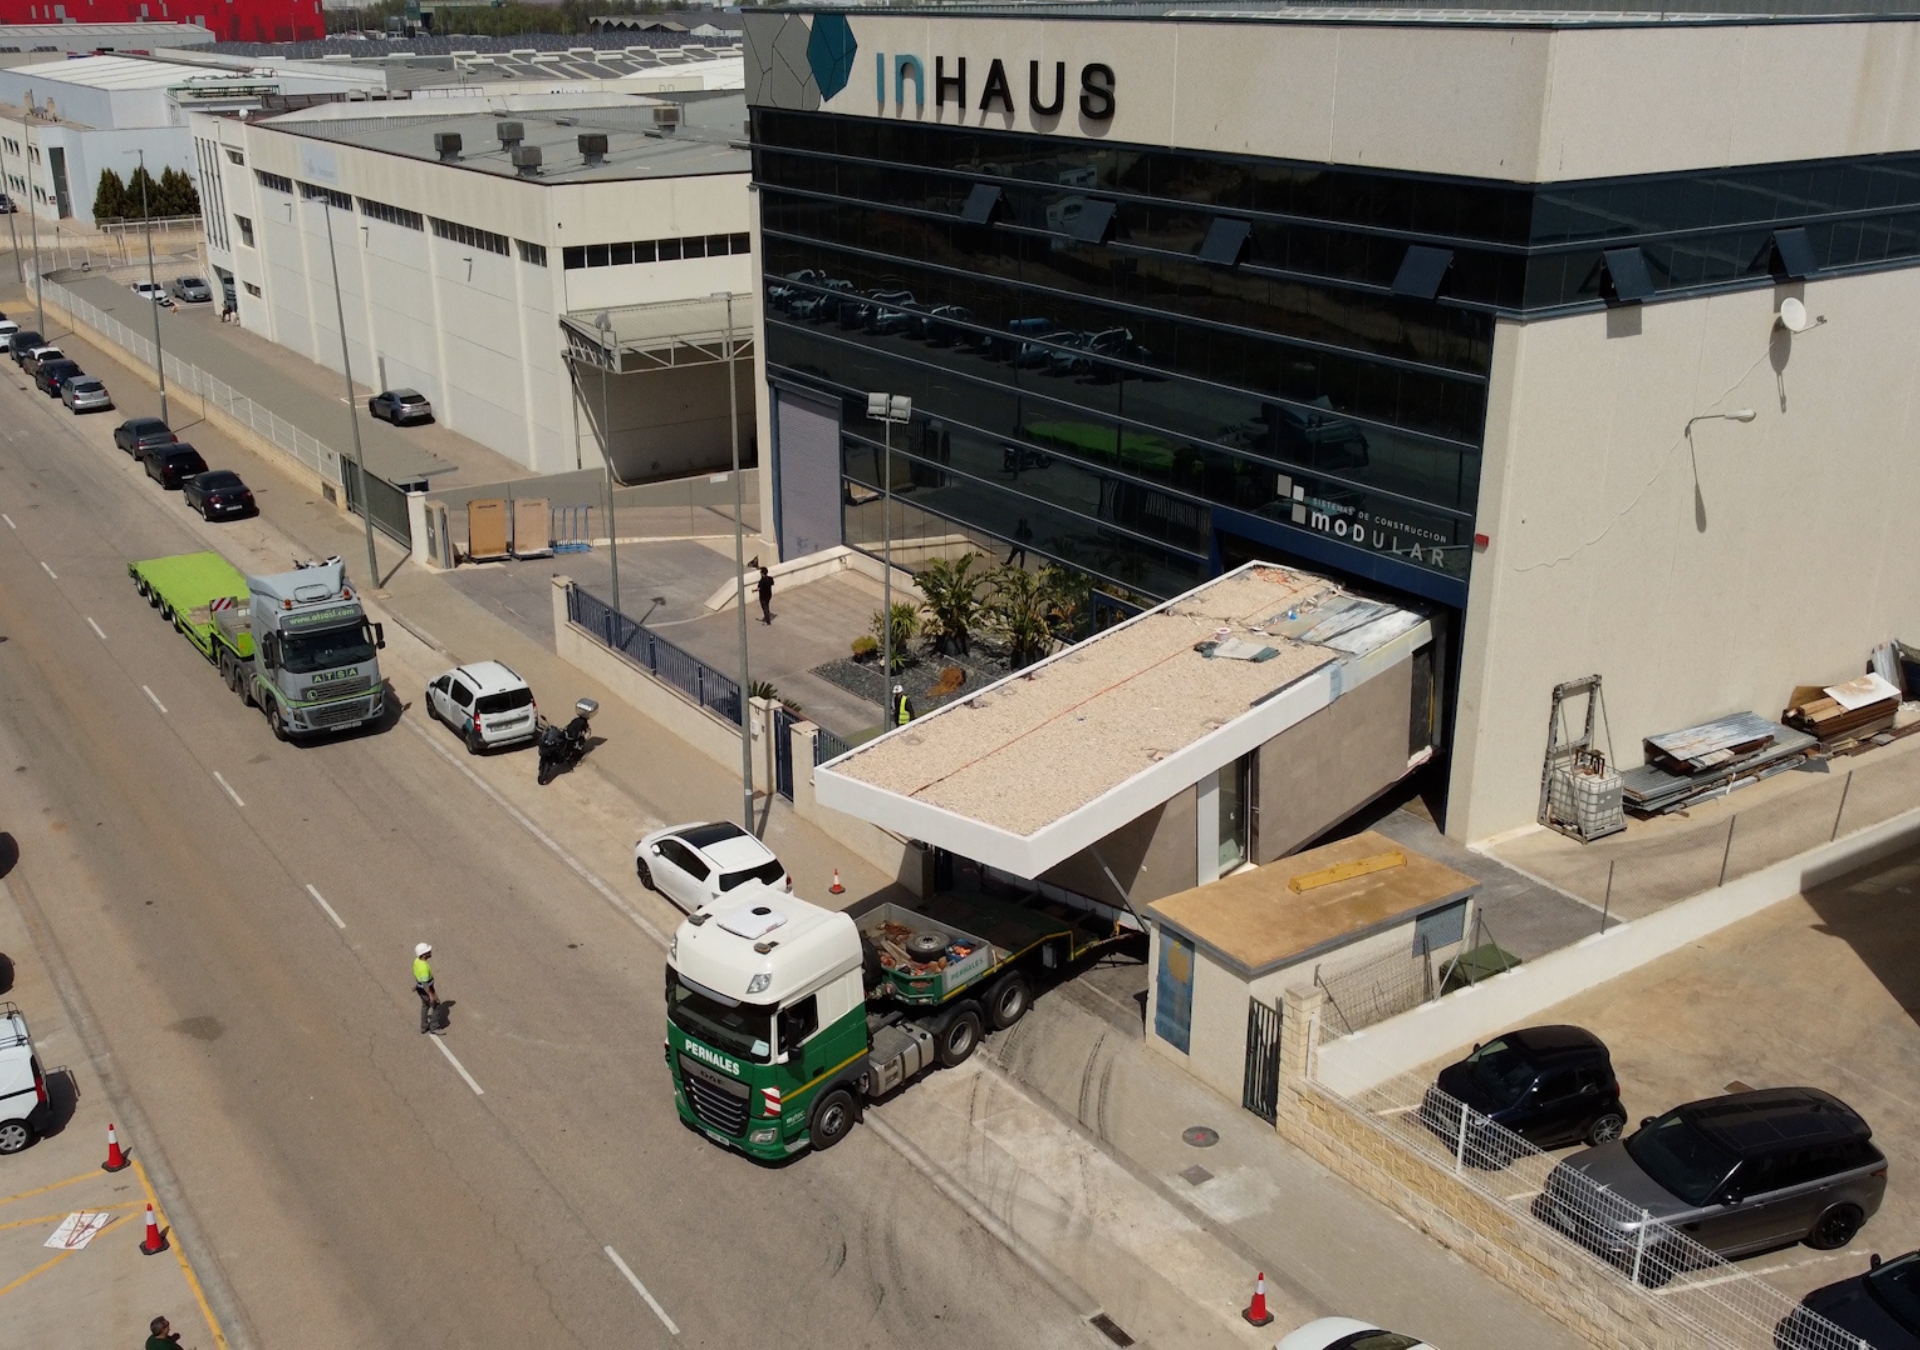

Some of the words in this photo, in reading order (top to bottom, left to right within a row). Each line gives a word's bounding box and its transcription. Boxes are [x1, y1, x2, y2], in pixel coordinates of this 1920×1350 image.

[1312, 497, 1355, 516] SISTEMAS
[1358, 510, 1370, 521] DE
[1374, 515, 1447, 543] CONSTRUCCION
[314, 668, 357, 683] ATSA
[685, 1038, 740, 1076] PERNALES
